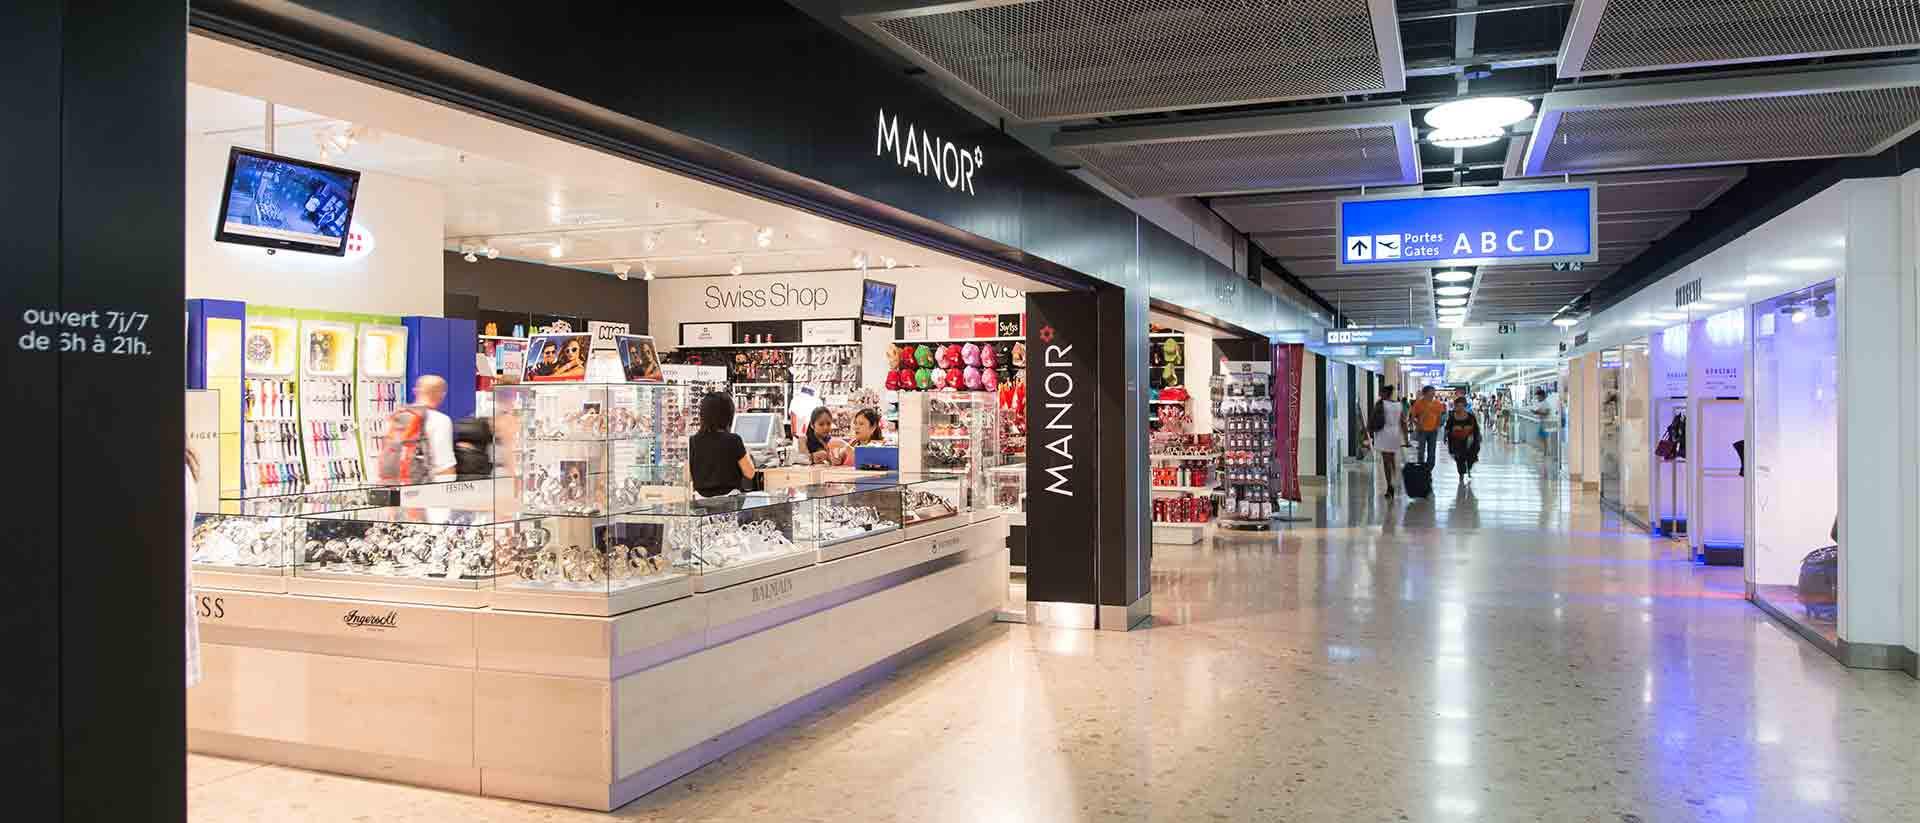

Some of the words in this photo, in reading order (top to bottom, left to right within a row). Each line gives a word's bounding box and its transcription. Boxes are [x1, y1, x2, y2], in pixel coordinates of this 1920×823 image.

[877, 106, 975, 196] MANOR
[1404, 232, 1443, 245] Portes
[1453, 232, 1473, 255] A
[1481, 231, 1497, 254] B
[1506, 229, 1525, 252] C
[1534, 228, 1554, 251] D
[1404, 246, 1440, 257] Gates
[704, 284, 765, 310] Swiss
[769, 281, 828, 310] Shop
[23, 308, 101, 328] ouvert
[106, 311, 149, 333] 7j/7
[18, 330, 51, 350] de
[92, 334, 106, 352] à
[111, 336, 152, 355] 21h.
[1044, 343, 1074, 497] MANOR
[196, 595, 225, 619] SS
[343, 608, 398, 628] Ingersoll
